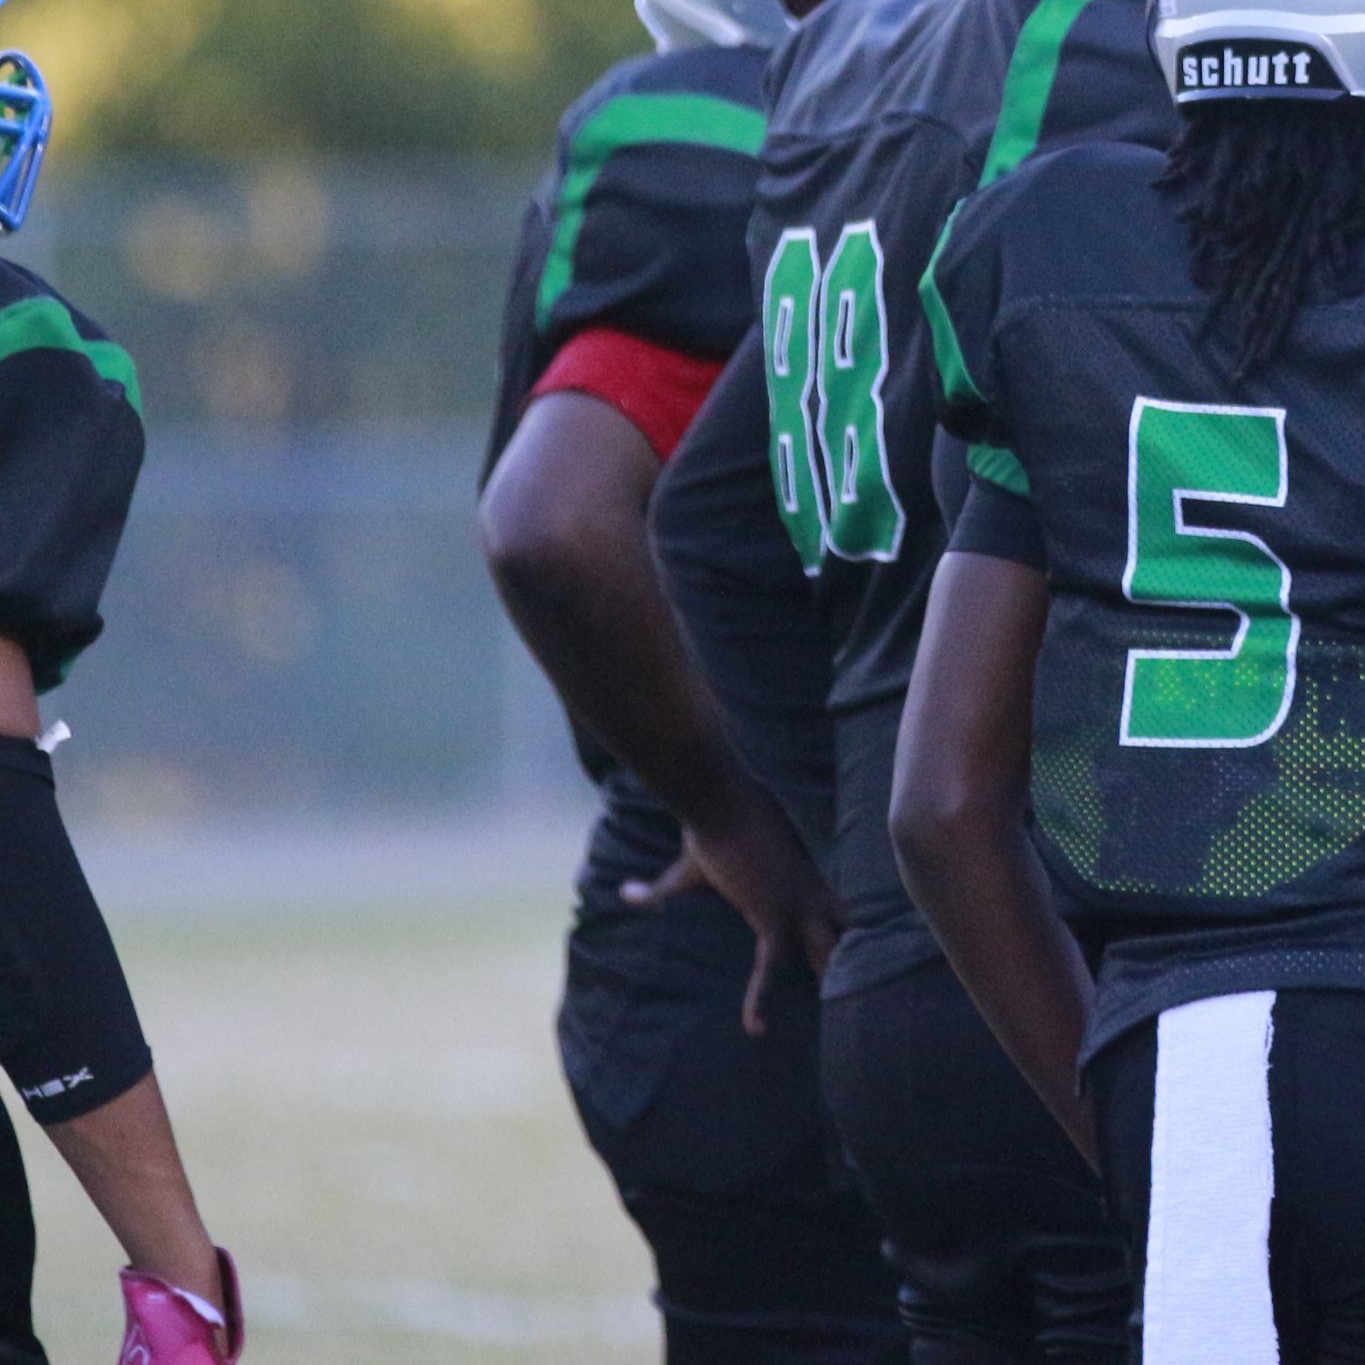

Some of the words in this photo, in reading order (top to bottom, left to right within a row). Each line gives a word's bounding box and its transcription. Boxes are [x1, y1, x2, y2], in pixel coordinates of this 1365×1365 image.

[1182, 46, 1312, 87] schutt
[763, 220, 906, 579] 88
[1119, 395, 1302, 750] 5
